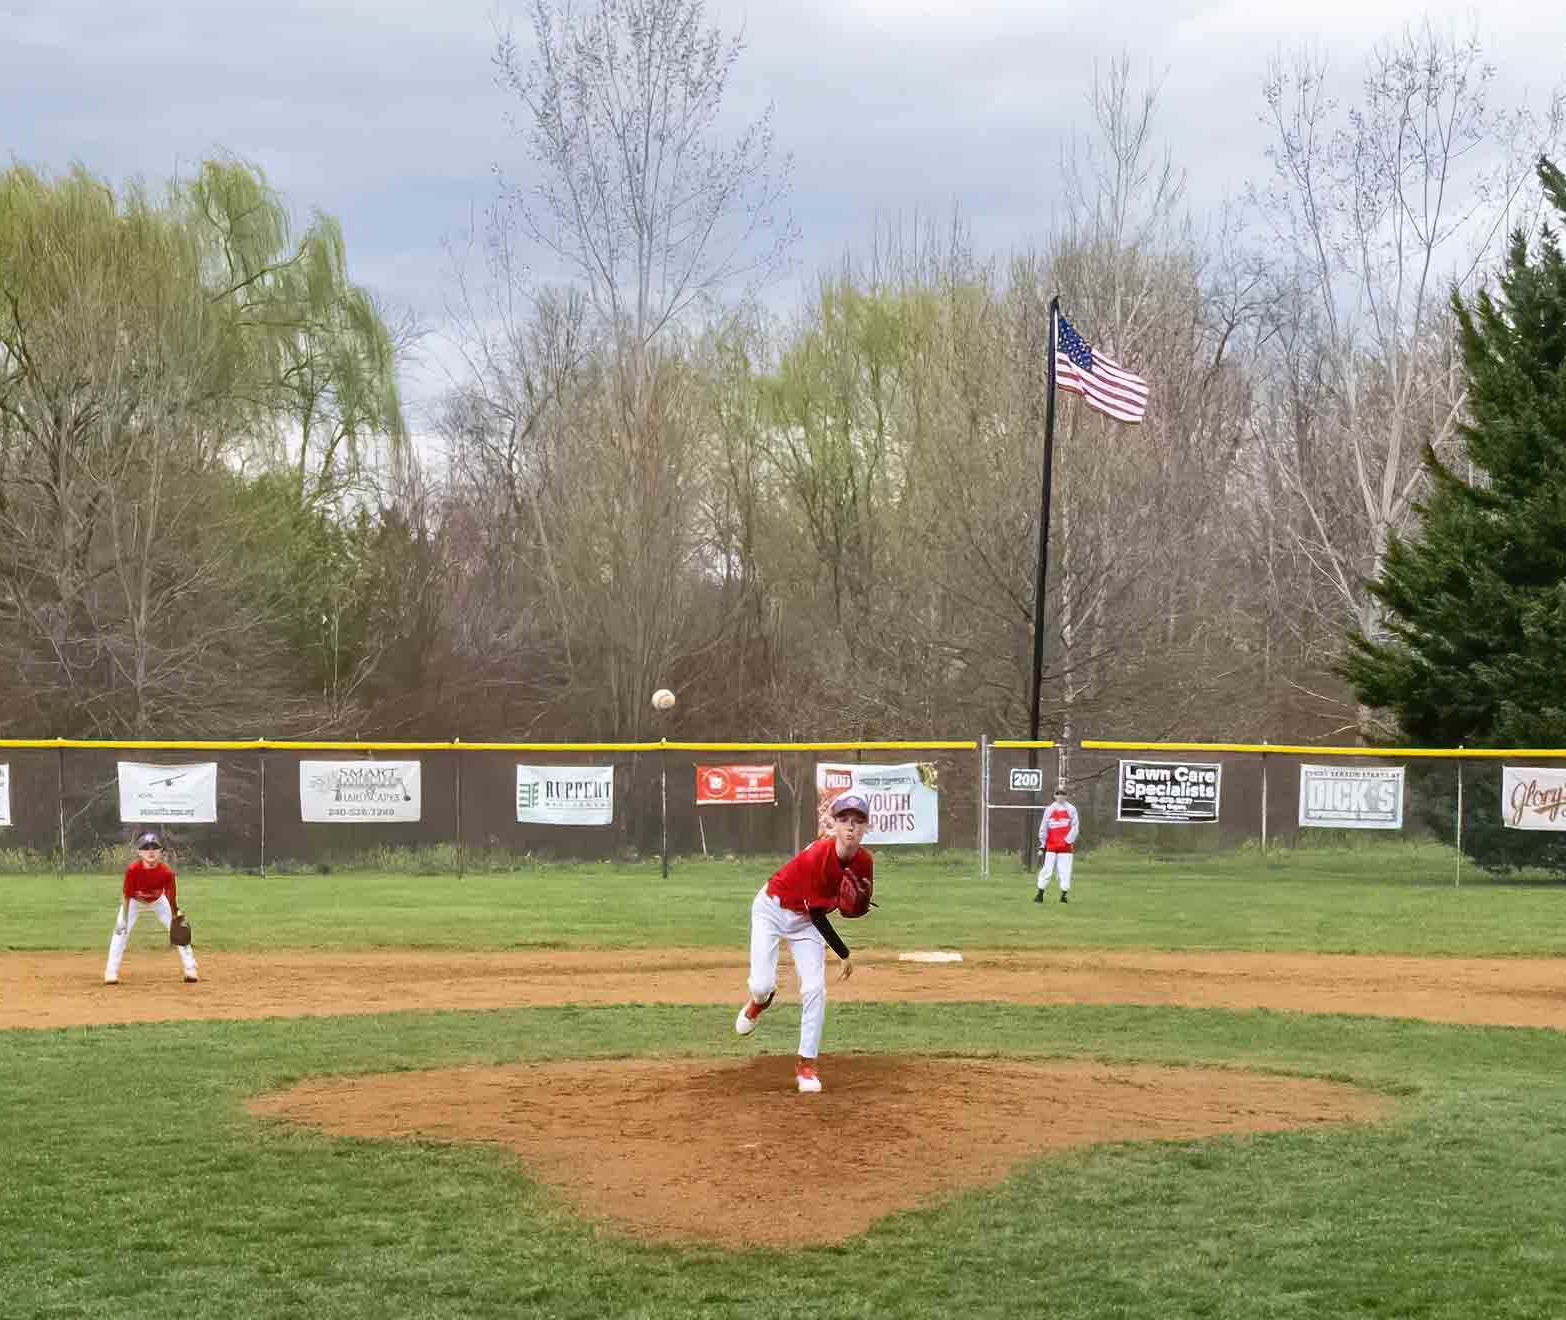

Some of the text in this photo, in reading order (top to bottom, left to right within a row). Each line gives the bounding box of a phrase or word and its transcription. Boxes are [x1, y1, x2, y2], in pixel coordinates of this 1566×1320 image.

[339, 768, 398, 777] SMART
[1014, 774, 1038, 786] 200
[1125, 765, 1215, 783] Lawn Care
[1124, 780, 1215, 799] Specialists
[866, 793, 911, 811] YOUTH
[1511, 779, 1562, 825] Glory
[867, 814, 915, 832] PORTS
